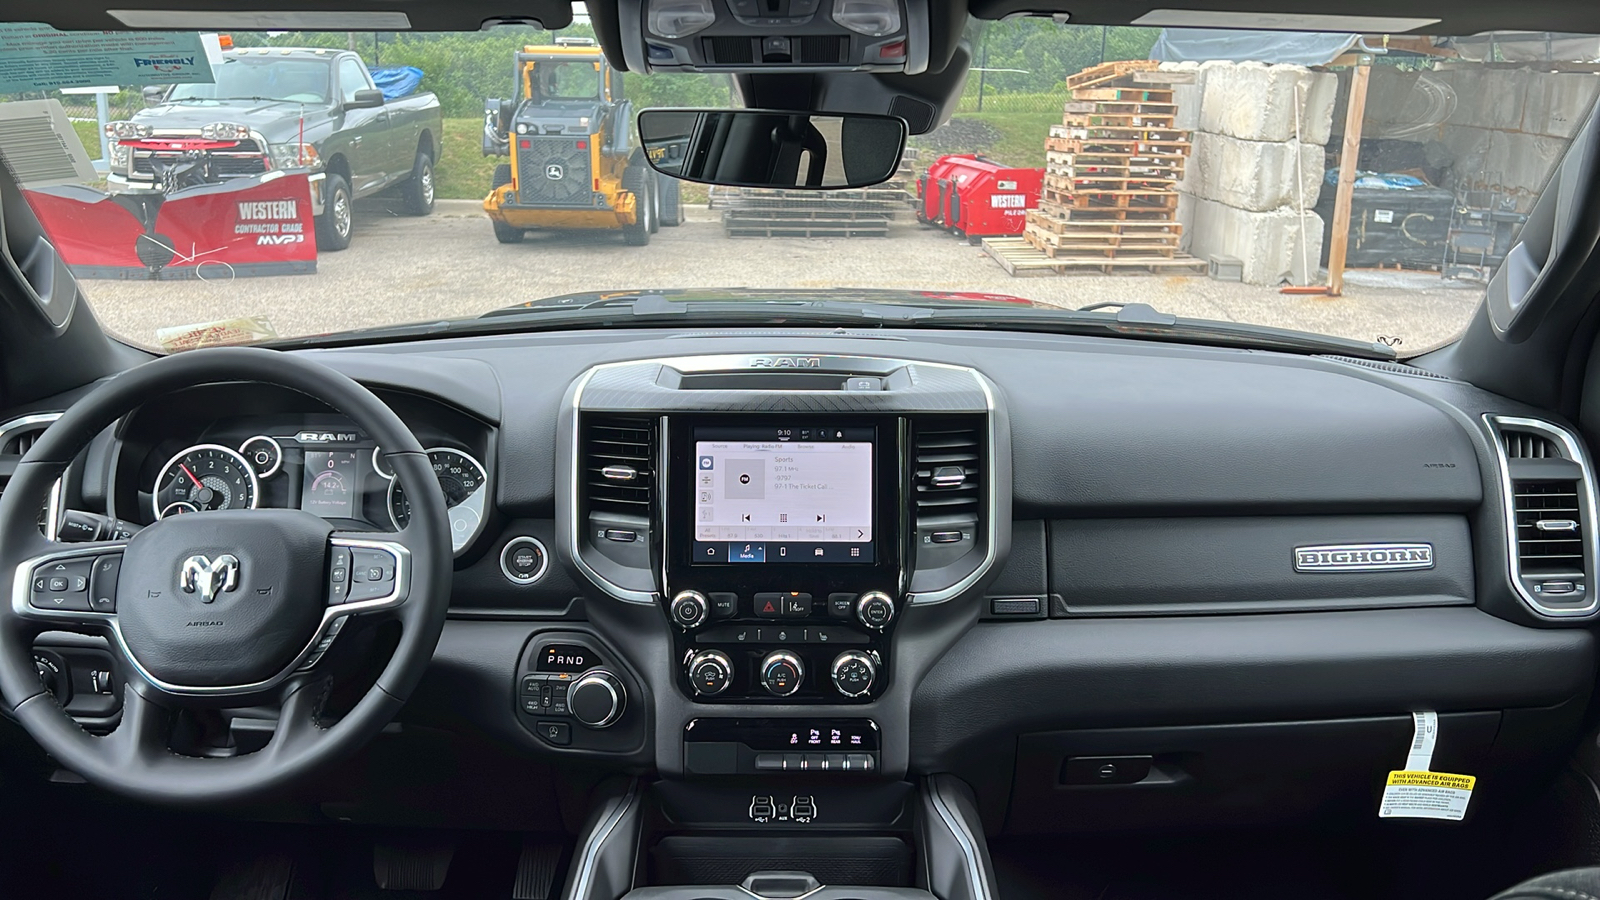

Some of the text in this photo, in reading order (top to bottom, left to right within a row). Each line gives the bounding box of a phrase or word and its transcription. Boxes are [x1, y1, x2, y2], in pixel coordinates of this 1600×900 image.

[134, 57, 194, 67] FRIENDLY
[991, 194, 1026, 208] WESTERN
[239, 200, 296, 220] WESTERN
[235, 223, 303, 234] CONTRACTOR GRADE
[751, 358, 820, 368] RAM
[300, 433, 356, 441] RAM
[1300, 550, 1428, 565] BIGHORN
[48, 662, 58, 673] AUTO
